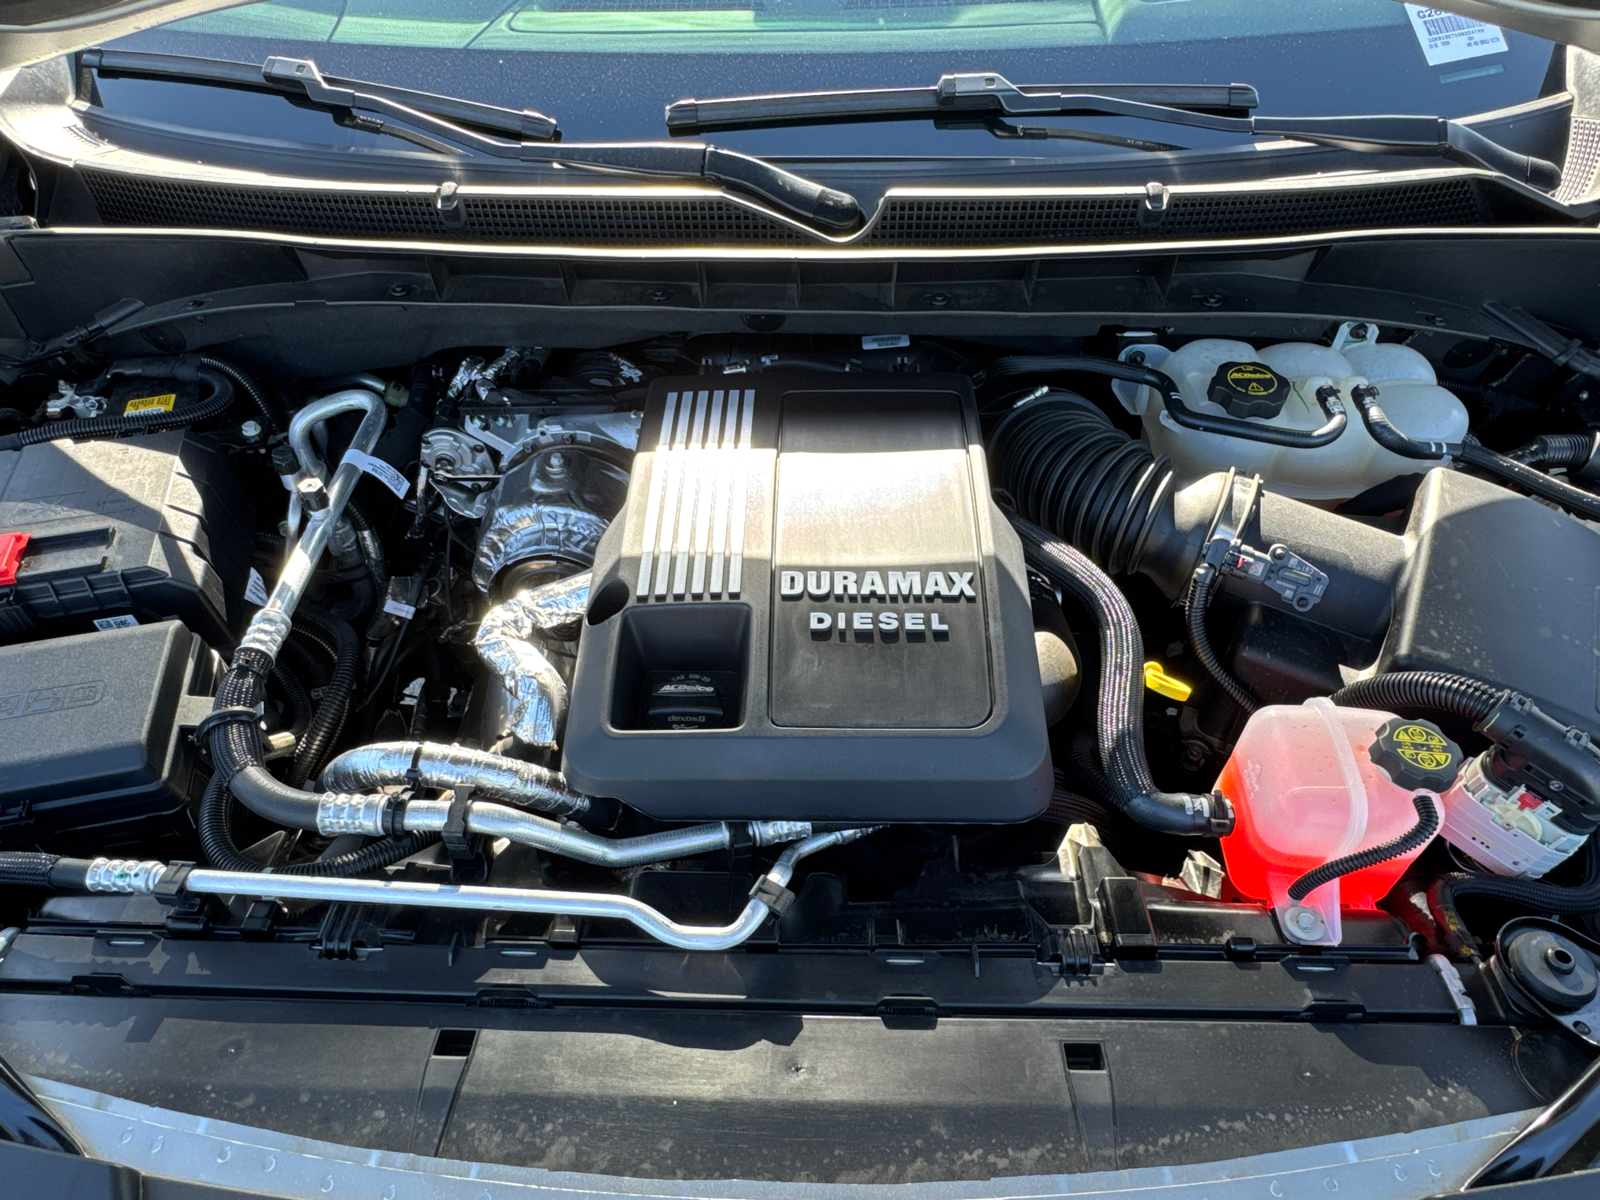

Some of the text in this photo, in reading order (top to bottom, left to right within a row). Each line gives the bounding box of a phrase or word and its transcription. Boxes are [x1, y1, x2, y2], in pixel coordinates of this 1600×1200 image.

[780, 571, 976, 597] DURAMAX
[809, 612, 949, 631] DIESEL
[659, 685, 714, 693] ACDelco
